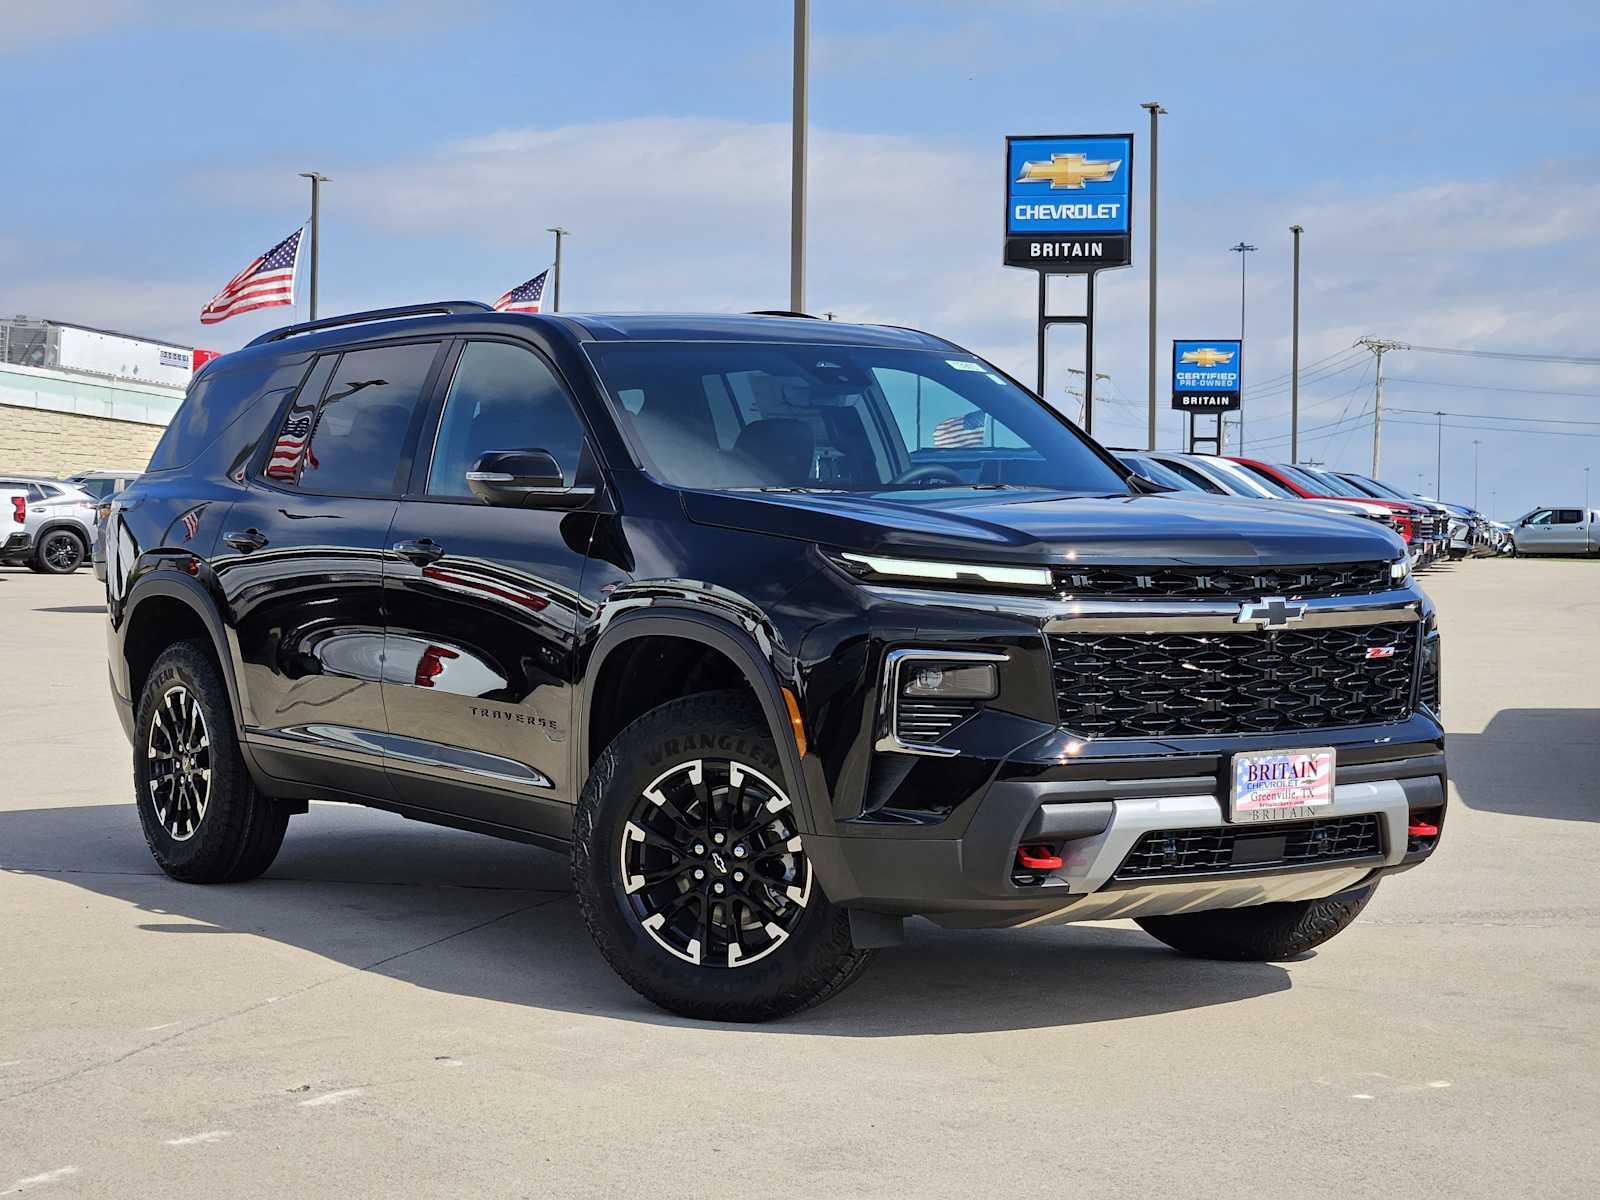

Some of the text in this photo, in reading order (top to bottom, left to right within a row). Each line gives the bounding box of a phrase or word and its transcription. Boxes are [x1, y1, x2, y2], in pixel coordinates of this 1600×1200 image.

[1015, 203, 1120, 220] CHEVROLET
[1030, 242, 1103, 257] BRITAIN
[1176, 372, 1237, 380] CERTIFIED
[1179, 379, 1233, 387] PRE-OWNED
[1182, 396, 1230, 405] BRITAIN
[468, 706, 558, 729] TRAVERSE
[1248, 760, 1319, 782] BRITAIN
[1247, 779, 1299, 790] CHEVROLET
[1302, 788, 1315, 799] TX
[1252, 806, 1316, 820] BRITAIN
